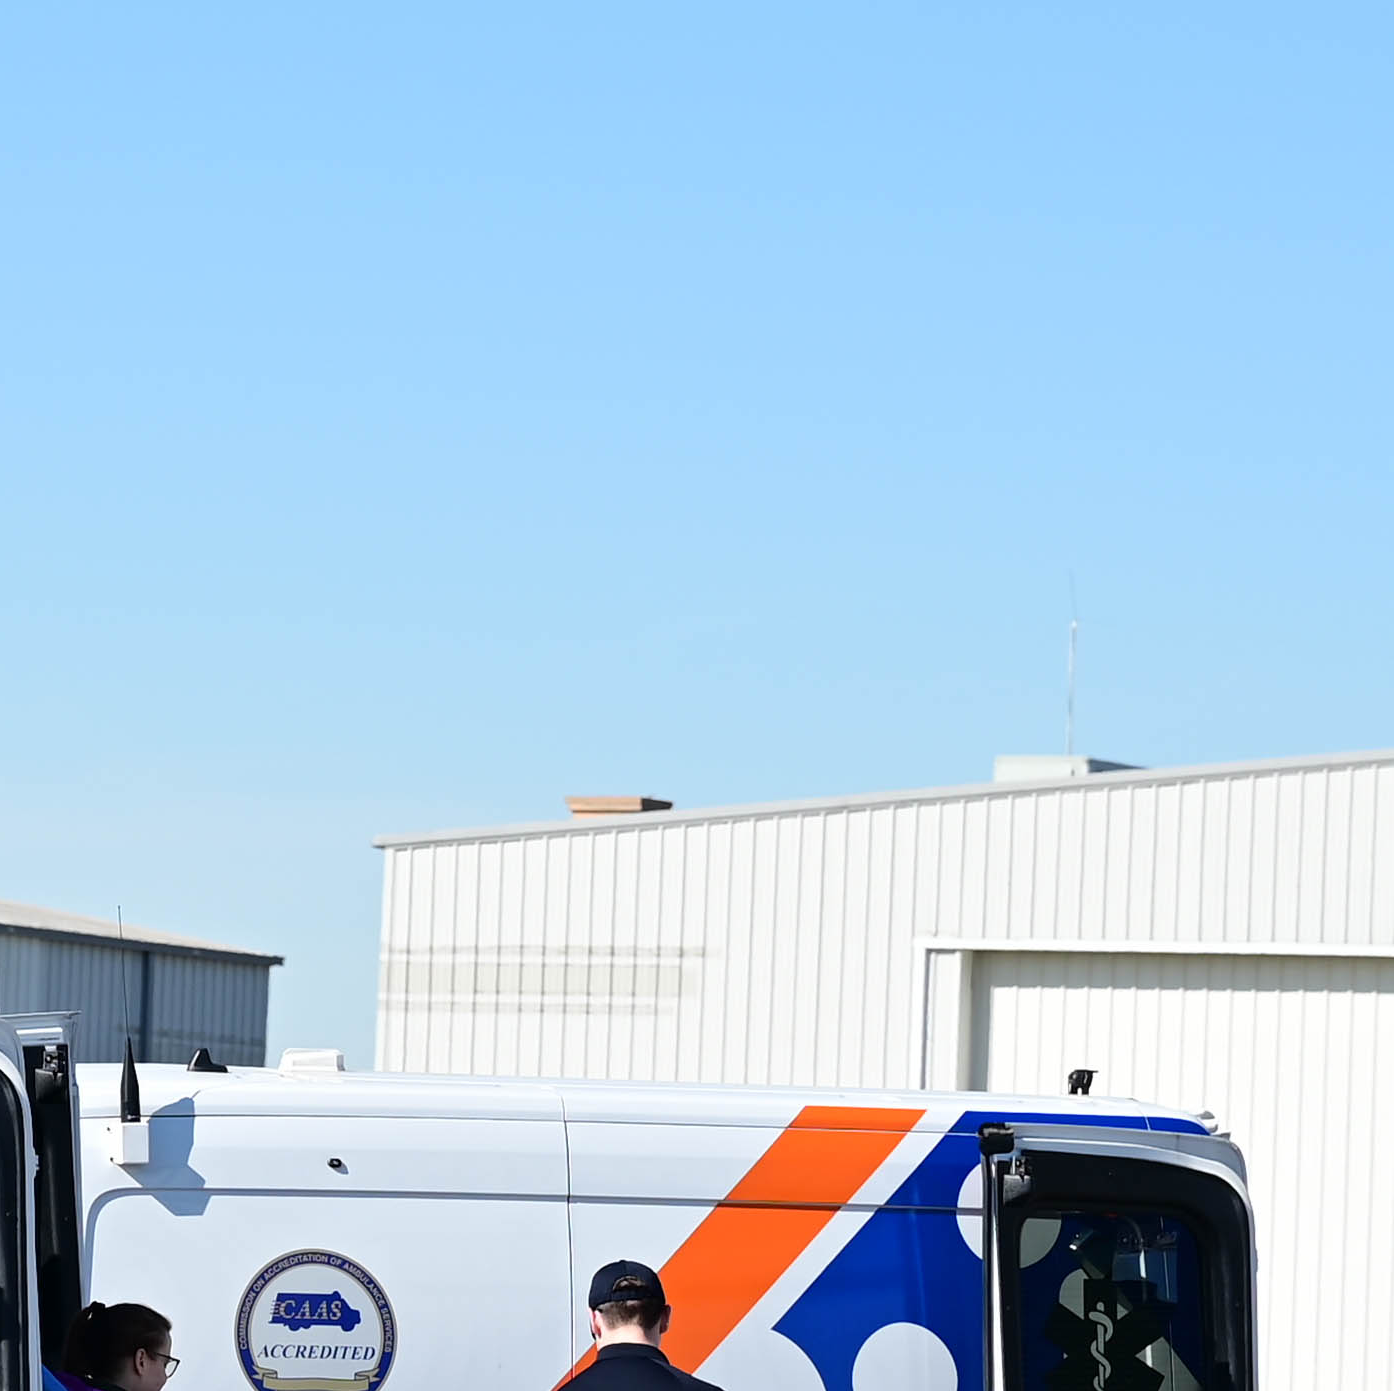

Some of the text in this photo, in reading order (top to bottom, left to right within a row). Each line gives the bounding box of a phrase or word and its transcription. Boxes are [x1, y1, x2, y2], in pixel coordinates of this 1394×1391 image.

[253, 1279, 265, 1292] ON
[329, 1257, 343, 1266] OF
[279, 1299, 342, 1321] CAAS
[257, 1343, 376, 1361] ACCREDITED
